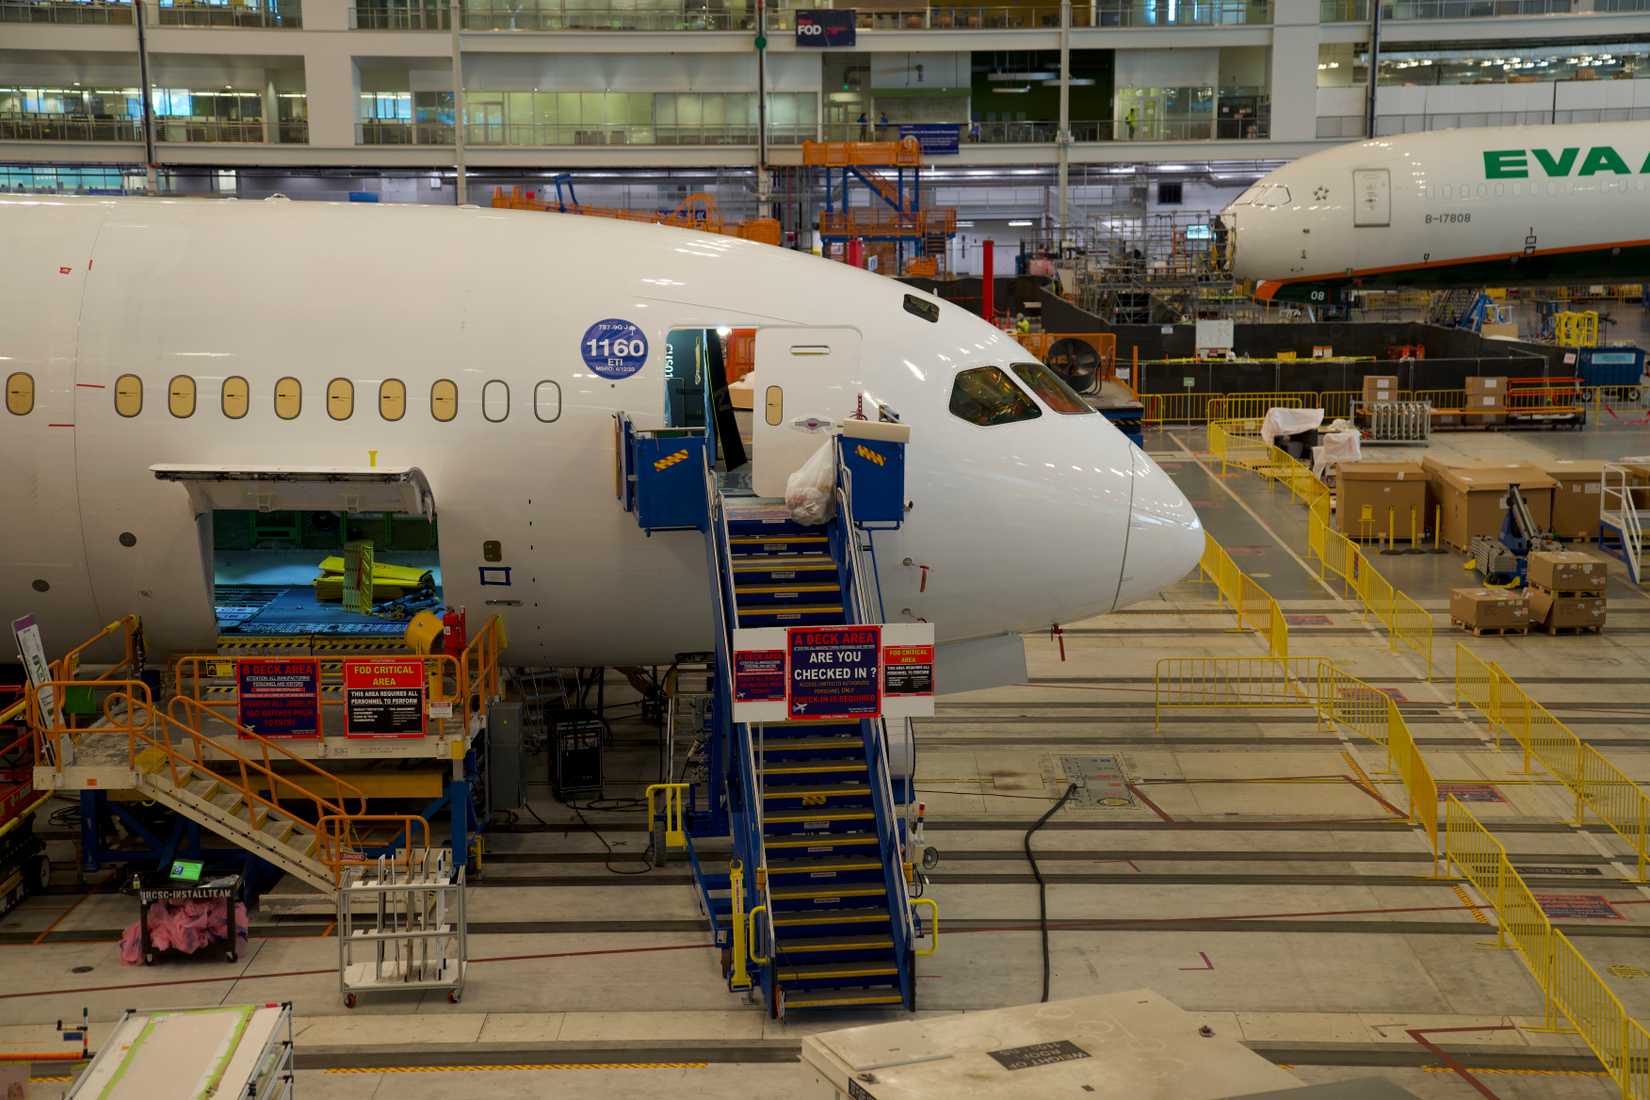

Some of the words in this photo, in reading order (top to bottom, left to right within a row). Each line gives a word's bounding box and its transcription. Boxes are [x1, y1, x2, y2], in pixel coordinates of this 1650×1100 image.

[798, 25, 822, 35] FOD
[1483, 146, 1632, 179] EVA
[1425, 213, 1471, 224] B-17808
[1311, 291, 1325, 301] 08
[587, 339, 644, 357] 1160
[608, 358, 623, 366] ETI
[795, 635, 803, 645] A
[807, 634, 837, 645] DECK
[843, 633, 874, 644] AREA
[809, 652, 833, 663] ARE
[837, 651, 861, 662] YOU
[254, 664, 281, 674] DECK
[285, 664, 313, 674] AREA
[355, 666, 371, 674] FOD
[374, 666, 415, 674] CRITICAL
[794, 668, 851, 680] CHECKED
[854, 667, 867, 678] IN
[870, 667, 877, 678] ?
[373, 678, 397, 686] AREA
